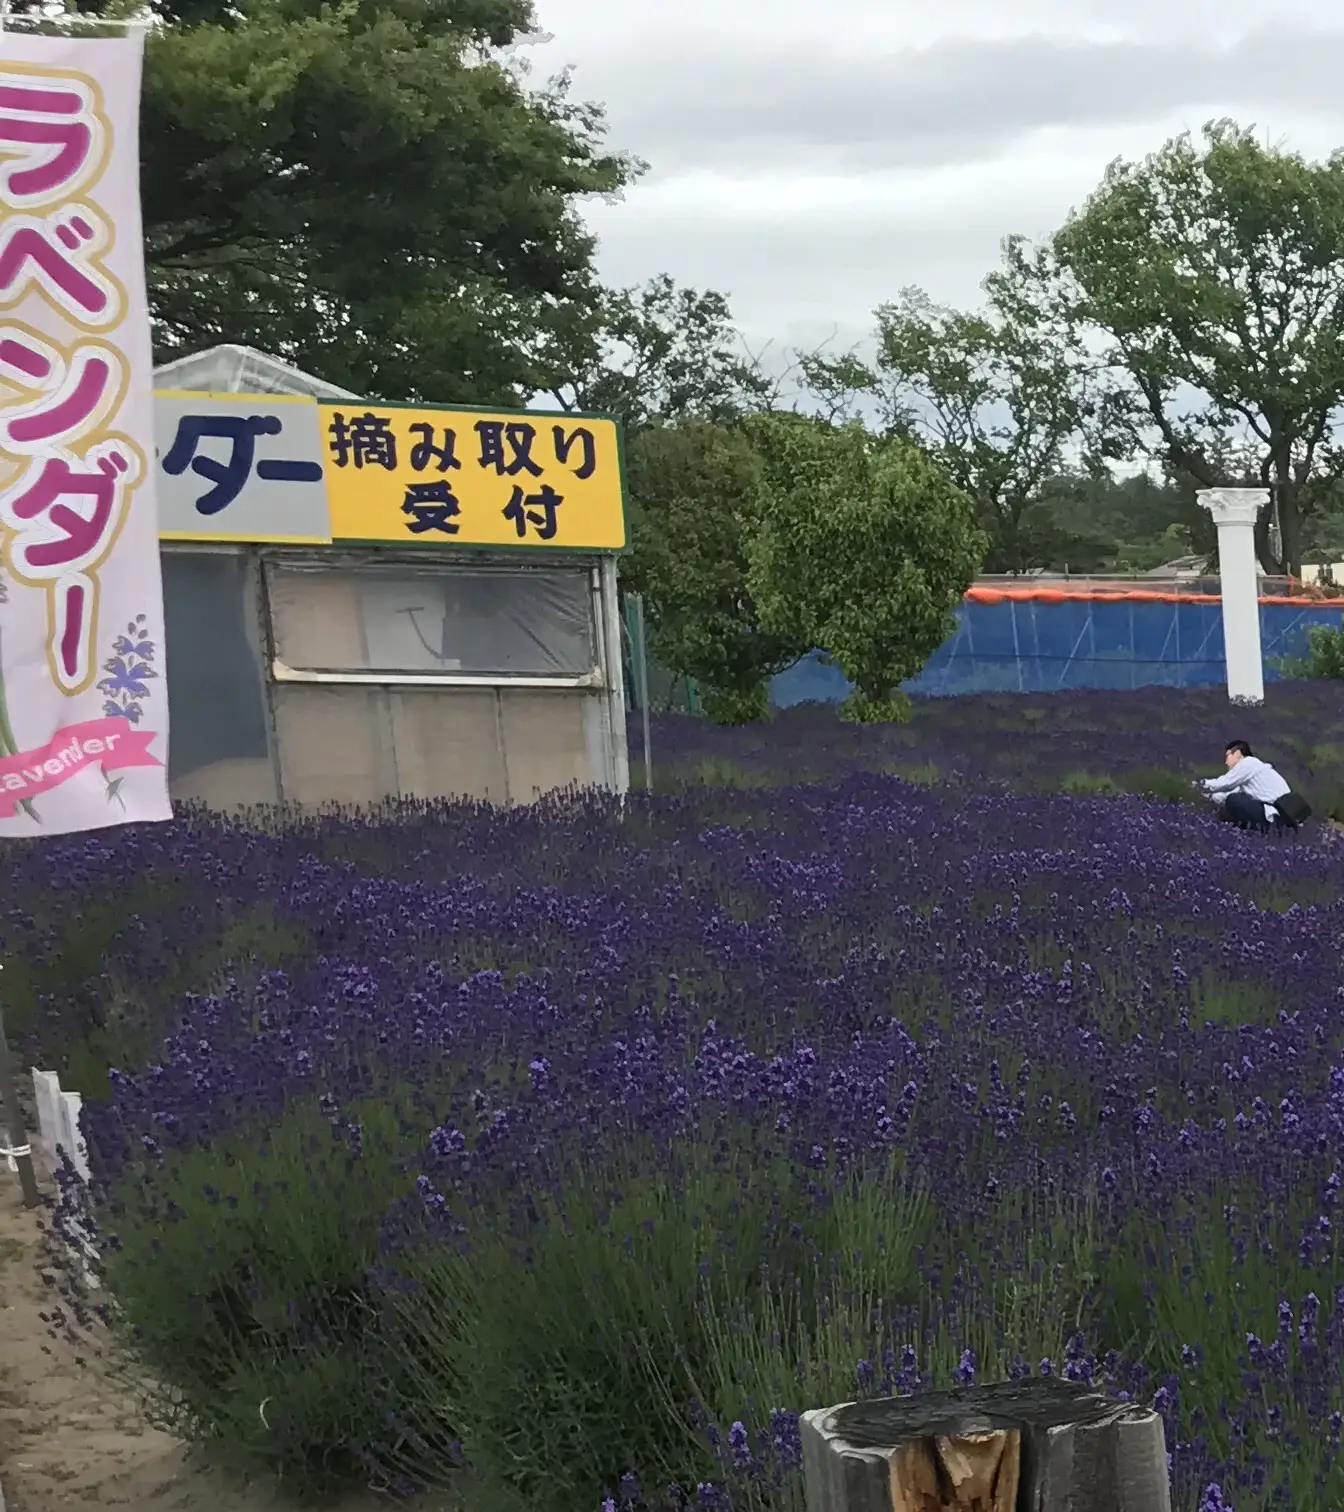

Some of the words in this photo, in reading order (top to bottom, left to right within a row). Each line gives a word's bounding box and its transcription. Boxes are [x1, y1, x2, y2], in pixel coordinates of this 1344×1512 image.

[0, 84, 131, 680] ラベンダー
[156, 415, 323, 516] ダー
[328, 412, 597, 480] 摘み取り
[400, 479, 565, 540] 受付
[0, 734, 121, 794] avender
